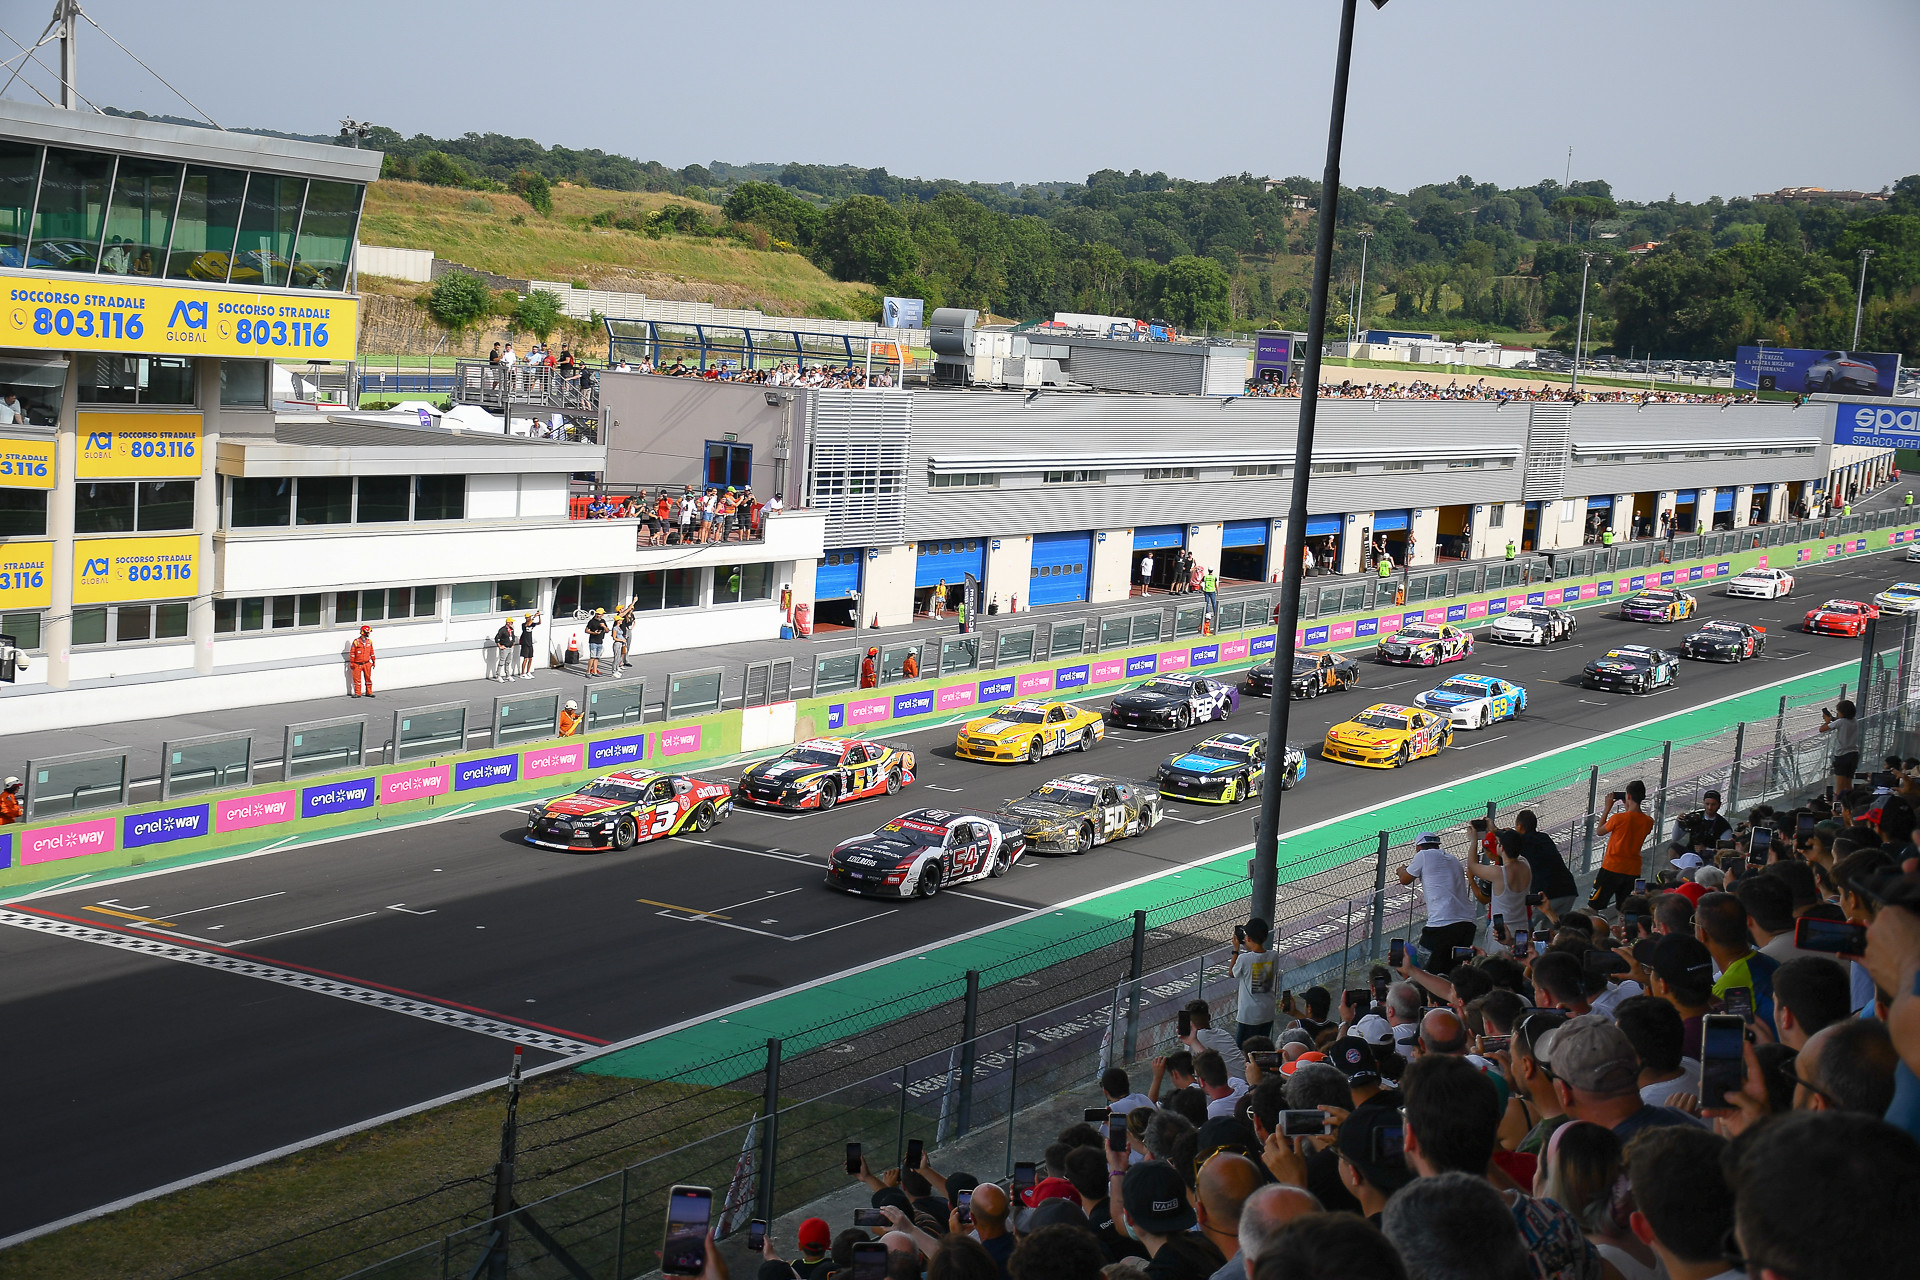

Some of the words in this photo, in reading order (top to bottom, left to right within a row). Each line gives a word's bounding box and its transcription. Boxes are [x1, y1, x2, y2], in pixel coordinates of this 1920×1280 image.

[10, 289, 80, 305] SOCCORSO
[84, 294, 146, 310] STRADALE
[217, 302, 275, 317] SOCCORSO
[279, 306, 331, 320] STRADALE
[32, 307, 145, 340] 803.116
[166, 331, 207, 343] GLOBAL
[235, 318, 329, 348] 803.116
[118, 431, 158, 439] SOCCORSO
[159, 431, 196, 439] STRADALE
[84, 452, 112, 460] GLOBAL
[130, 441, 196, 458] 803.116
[5, 453, 48, 462] STRADALE
[3, 562, 44, 570] STRADALE
[115, 555, 155, 564] SOCCORSO
[156, 554, 192, 563] STRADALE
[128, 564, 192, 582] 803.116
[80, 576, 109, 586] GLOBAL
[1060, 671, 1071, 682] enel
[1076, 671, 1086, 680] way
[1095, 666, 1106, 676] enel
[1111, 666, 1120, 675] way
[983, 684, 996, 695] enel
[1001, 683, 1012, 693] way
[1022, 678, 1034, 688] enel
[1039, 677, 1050, 686] way
[942, 691, 955, 702] enel
[960, 690, 972, 700] way
[853, 705, 867, 717] enel
[873, 705, 886, 715] way
[898, 698, 912, 710] enel
[918, 698, 930, 708] way
[1196, 697, 1213, 718] 66
[1493, 698, 1507, 718] 69
[662, 735, 677, 748] nel
[683, 734, 696, 746] way
[1054, 728, 1066, 750] 18
[1416, 728, 1429, 754] 34
[595, 745, 613, 759] enel
[622, 744, 638, 756] way
[531, 755, 551, 769] enel
[560, 754, 577, 765] way
[463, 766, 484, 781] enel
[493, 764, 512, 776] way
[390, 778, 412, 793] enel
[422, 776, 442, 788] way
[606, 778, 635, 786] WHELEN
[853, 770, 865, 794] 5
[311, 790, 335, 806] enel
[346, 788, 367, 801] way
[227, 804, 252, 820] enel
[264, 802, 286, 815] way
[650, 801, 679, 834] 3
[134, 818, 162, 835] enel
[175, 815, 200, 830] way
[902, 821, 935, 832] WHELEN
[1104, 806, 1125, 833] 50
[883, 823, 902, 833] 54
[33, 834, 63, 851] enel
[78, 831, 104, 845] way
[859, 846, 902, 859] ITALIANBOX
[952, 845, 979, 877] 54
[1155, 1200, 1176, 1209] VANS
